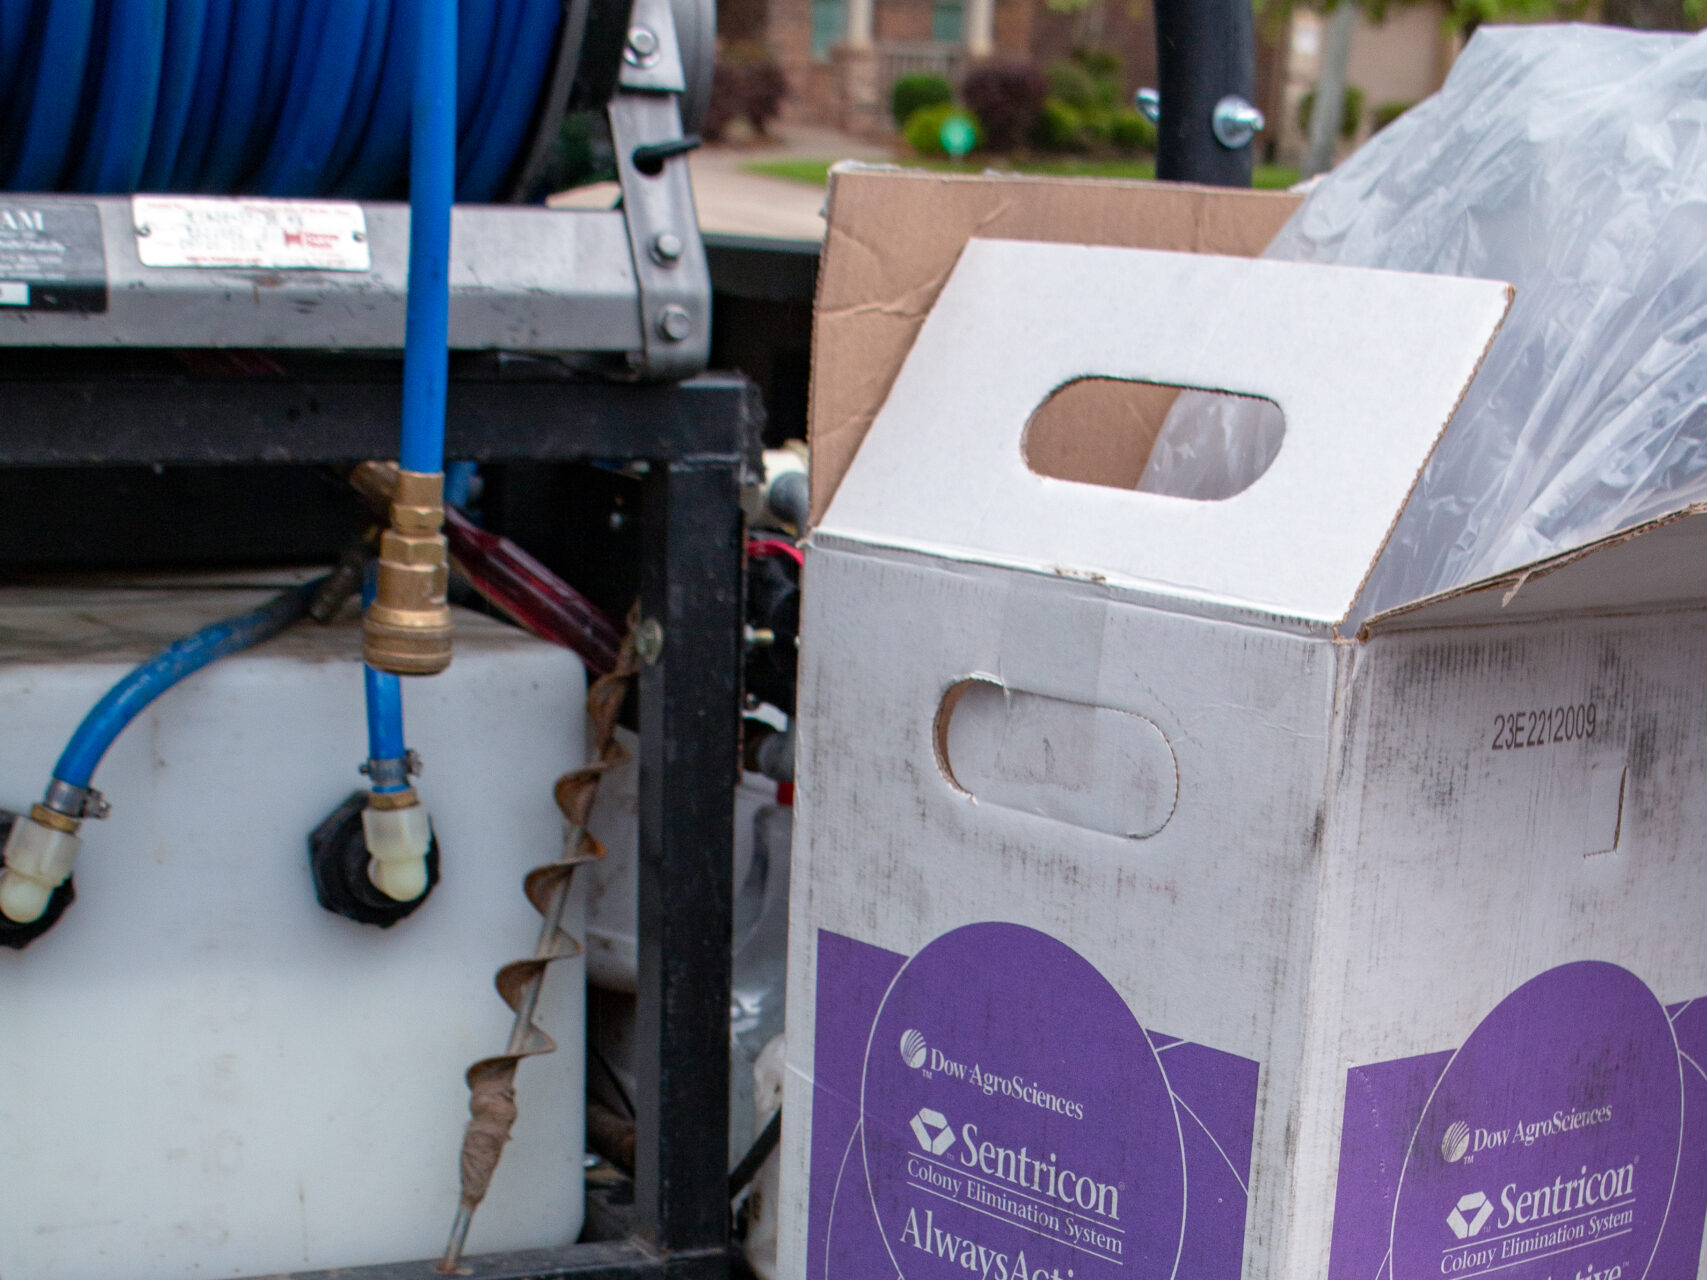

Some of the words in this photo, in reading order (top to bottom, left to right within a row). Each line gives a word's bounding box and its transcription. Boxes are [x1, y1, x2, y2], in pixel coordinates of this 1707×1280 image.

[1492, 703, 1596, 750] 23E2212009
[931, 1048, 968, 1081] Dow
[969, 1063, 1084, 1120] AgroSciences
[1472, 1128, 1511, 1152] Dow
[1512, 1105, 1613, 1147] AgroSciences
[908, 1159, 962, 1198] Colony
[967, 1180, 1059, 1231] Elimination
[1064, 1217, 1123, 1255] System
[1440, 1247, 1497, 1274] Colony
[1501, 1224, 1584, 1259] Elimination
[1588, 1209, 1633, 1238] System
